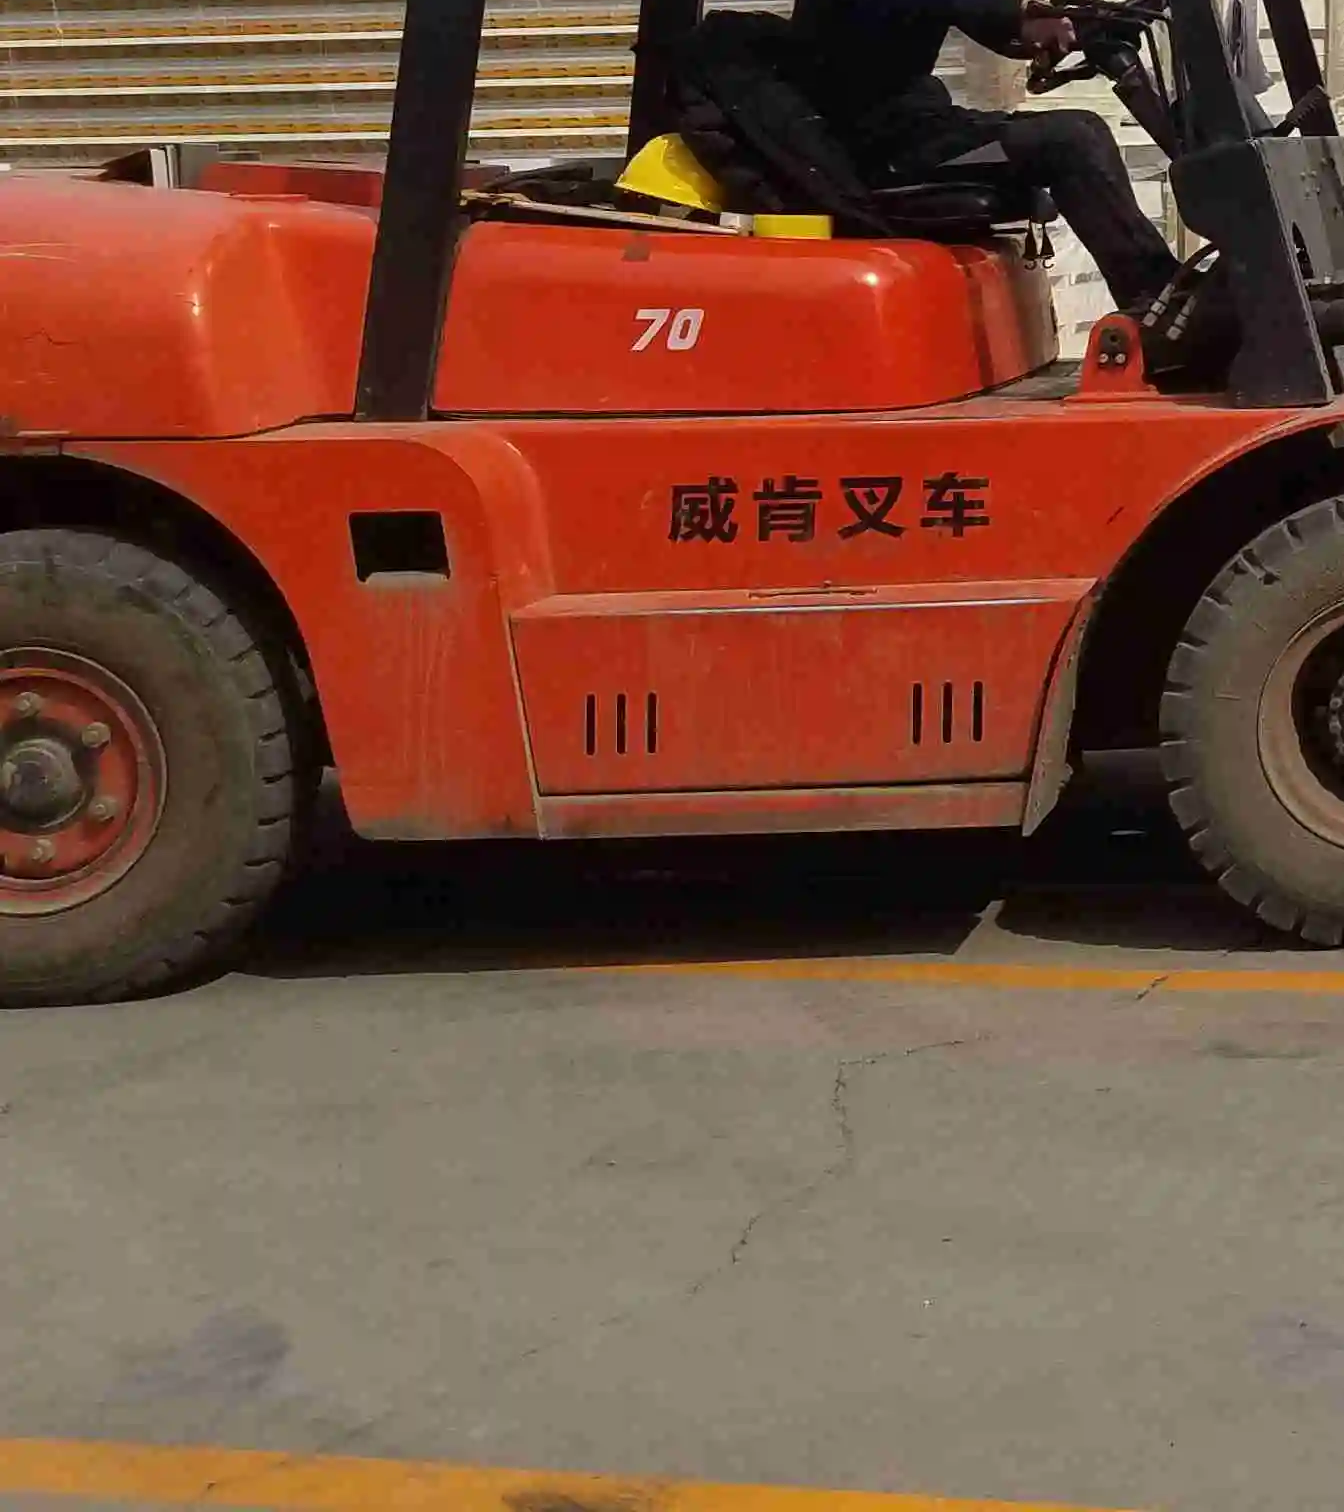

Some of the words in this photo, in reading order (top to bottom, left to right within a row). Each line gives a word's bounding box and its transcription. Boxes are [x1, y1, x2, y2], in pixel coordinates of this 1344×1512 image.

[629, 308, 705, 352] 70
[668, 471, 991, 544] 威肯叉车
